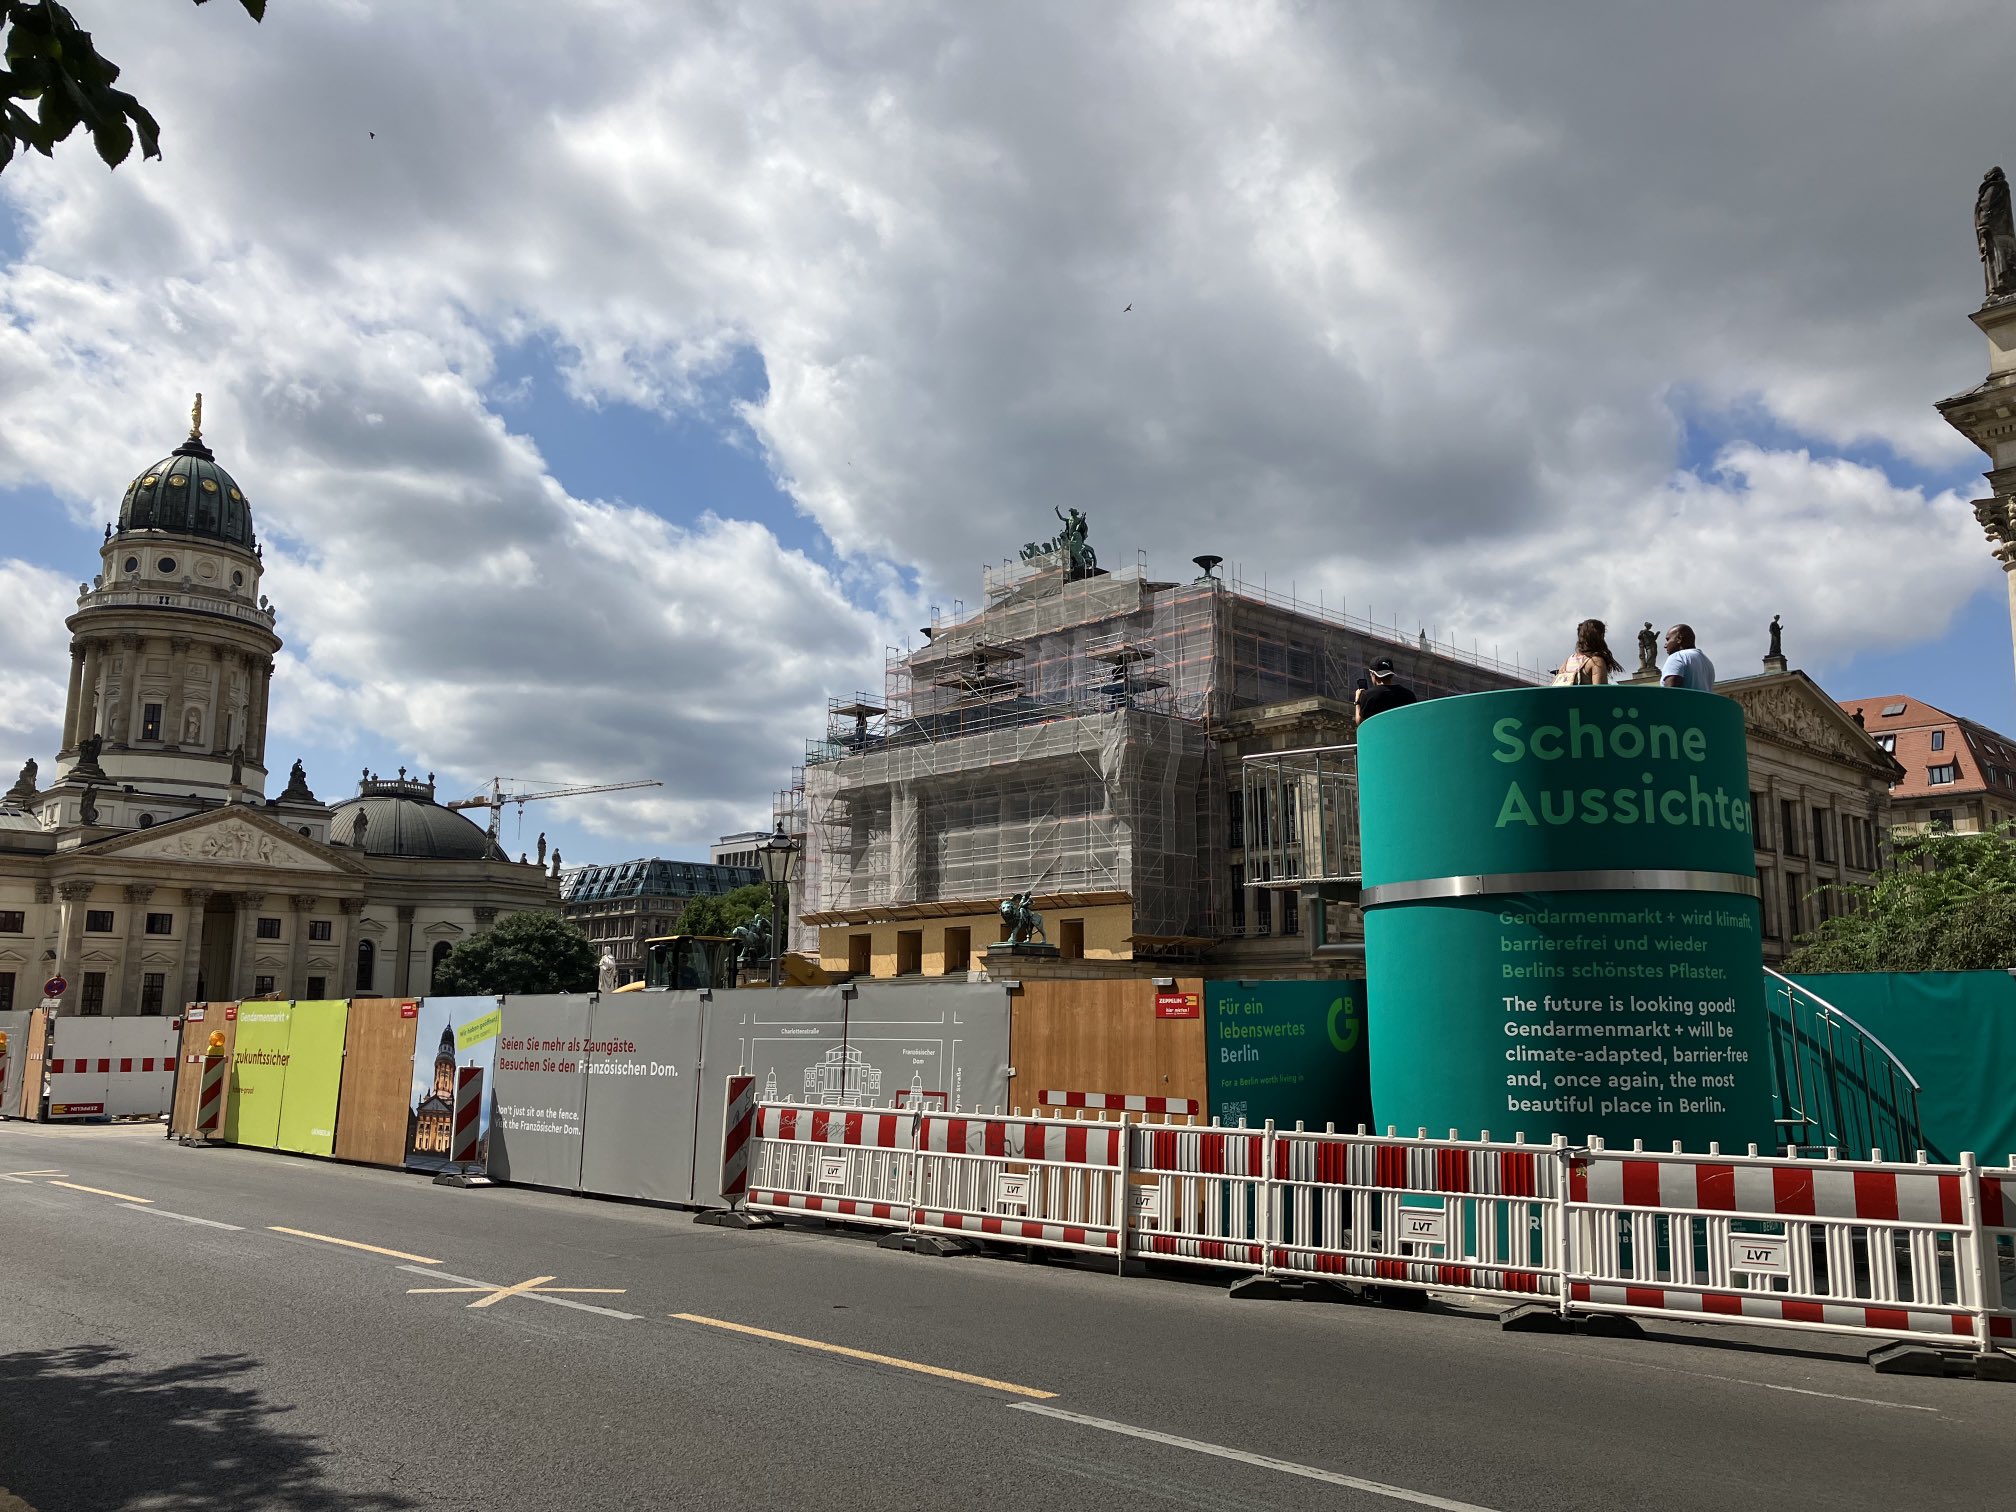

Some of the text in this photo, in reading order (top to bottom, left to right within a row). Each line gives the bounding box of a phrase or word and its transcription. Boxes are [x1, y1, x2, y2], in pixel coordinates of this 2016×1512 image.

[1491, 707, 1707, 763] Schöne
[1500, 908, 1663, 925] Gendarmenmarkt
[1681, 909, 1713, 926] wird
[1716, 911, 1753, 932] klimafit,
[1500, 935, 1708, 952] barrierefrei und wieder
[1502, 962, 1727, 980] Berlins schönstes Pflaster.
[1219, 998, 1264, 1015] Für ein
[1502, 995, 1736, 1016] The future is looking good!
[240, 1012, 285, 1022] Gendarmenmarkt
[1220, 1021, 1305, 1039] lebenswertes
[1504, 1020, 1671, 1037] Gendarmenmarkt
[1688, 1021, 1714, 1037] will
[1718, 1022, 1733, 1038] be
[501, 1037, 637, 1056] Seien Sie mehr als Zaungäste.
[1221, 1044, 1259, 1063] Berlin
[1505, 1045, 1749, 1065] climate-adapted, barrier-free
[235, 1048, 290, 1066] zukunftssicher
[500, 1058, 678, 1077] Besuchen Sie den Französischen Dom.
[1221, 1079, 1232, 1088] For
[1240, 1076, 1259, 1086] Berlin
[1260, 1074, 1279, 1084] worth
[1506, 1070, 1735, 1091] and, once again, the most
[512, 1106, 526, 1117] just
[526, 1106, 535, 1117] sit
[536, 1109, 545, 1117] on
[546, 1107, 557, 1118] the
[558, 1108, 580, 1121] fence.
[1507, 1095, 1726, 1116] beautiful place in Berlin.
[508, 1119, 520, 1129] the
[520, 1120, 563, 1134] Französischer
[563, 1125, 581, 1136] Dom.
[827, 1167, 839, 1175] LVT
[1006, 1186, 1020, 1194] LVT
[1135, 1197, 1150, 1206] LVT
[1412, 1221, 1432, 1232] LVT
[1747, 1250, 1772, 1261] LVT
